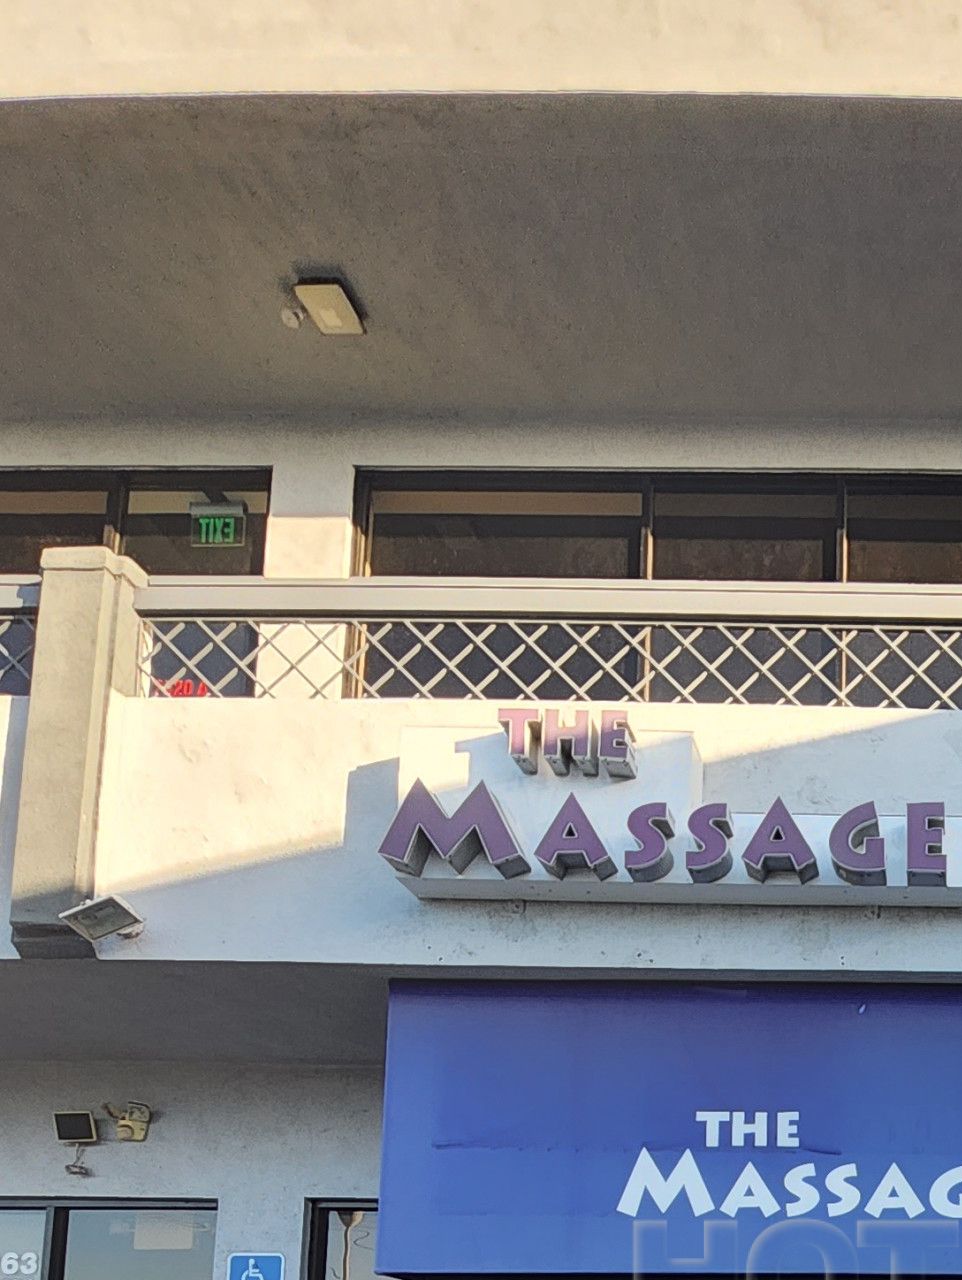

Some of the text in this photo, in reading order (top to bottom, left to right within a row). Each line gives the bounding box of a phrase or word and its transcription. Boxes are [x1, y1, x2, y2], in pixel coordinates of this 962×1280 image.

[497, 708, 630, 764] THE
[380, 777, 948, 878] MASSAGE
[695, 1110, 800, 1148] THE
